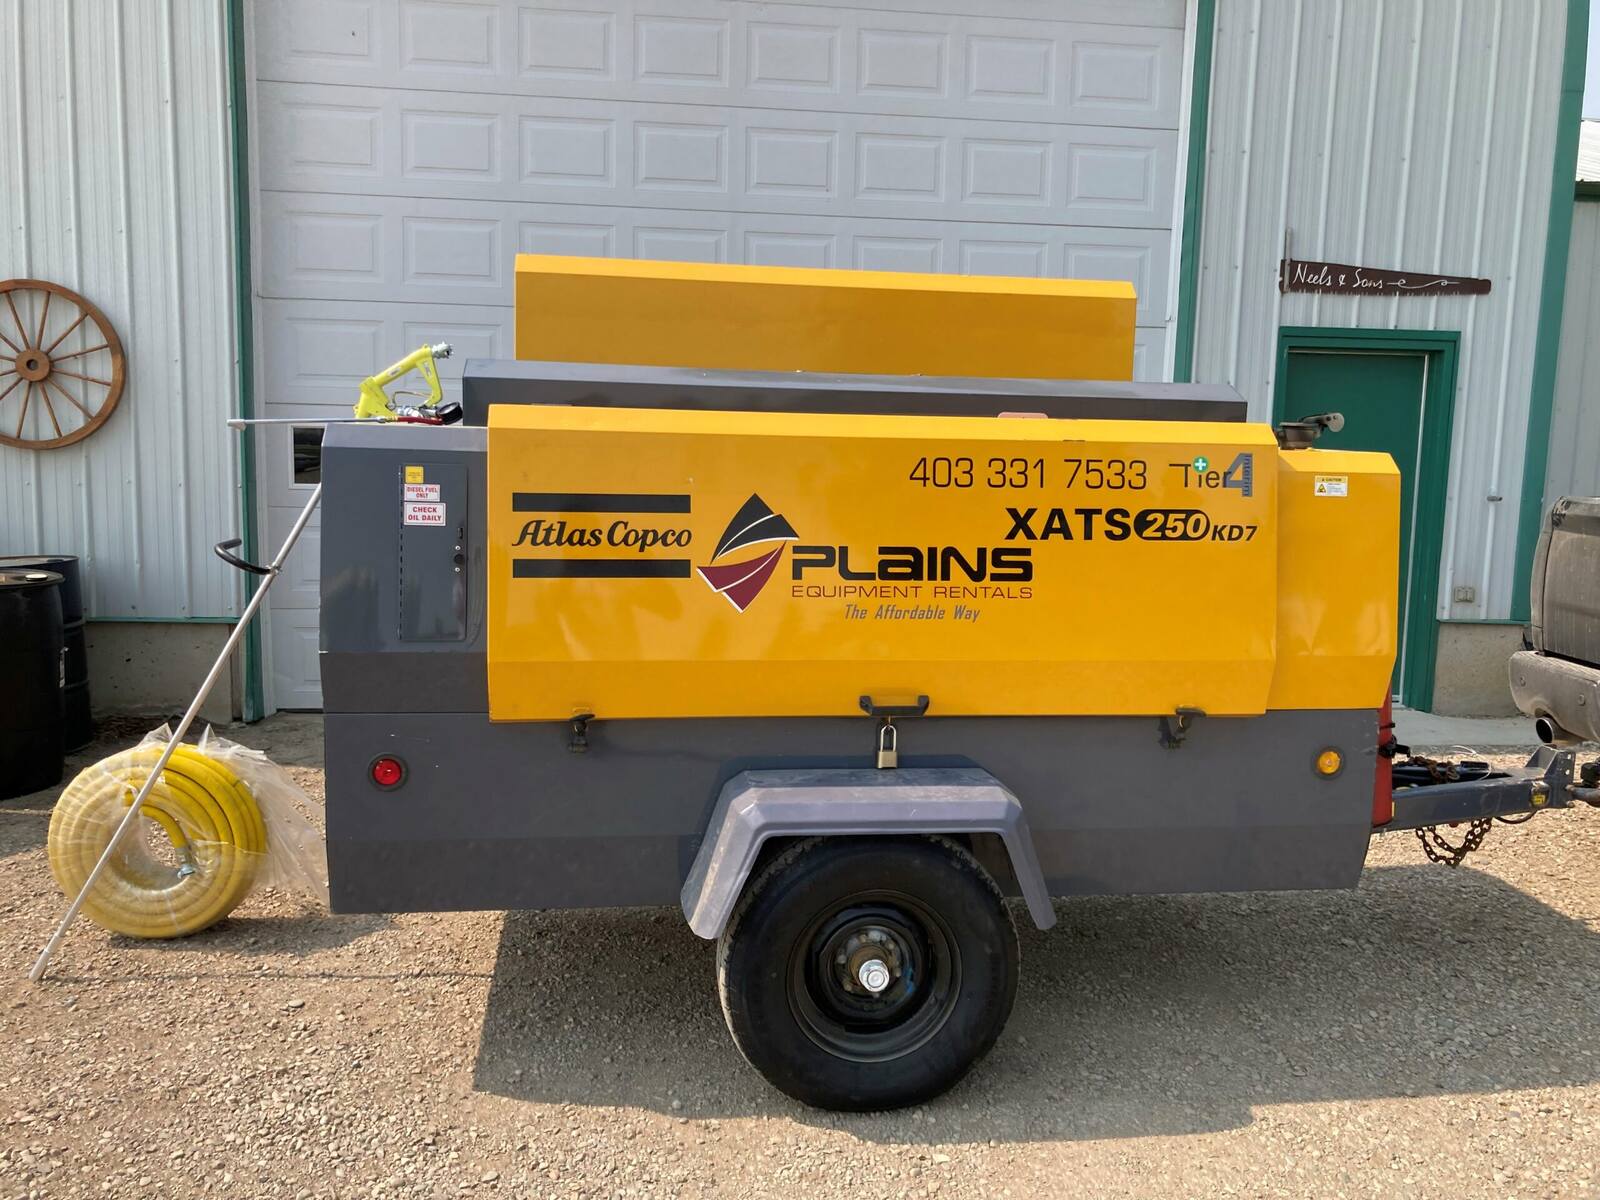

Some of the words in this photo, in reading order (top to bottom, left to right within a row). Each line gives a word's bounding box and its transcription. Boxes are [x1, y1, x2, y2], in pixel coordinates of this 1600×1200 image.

[1292, 263, 1333, 286] Neels
[1352, 268, 1384, 288] Sons
[909, 457, 974, 488] 403
[987, 458, 1045, 489] 331
[1063, 458, 1147, 490] 7533
[511, 519, 603, 547] Atlas
[606, 520, 692, 552] Copco
[791, 585, 922, 599] EQUIPMENT
[933, 586, 1033, 599] RENTALS
[844, 604, 867, 620] The
[875, 604, 945, 620] Affordable
[954, 605, 981, 623] Way
